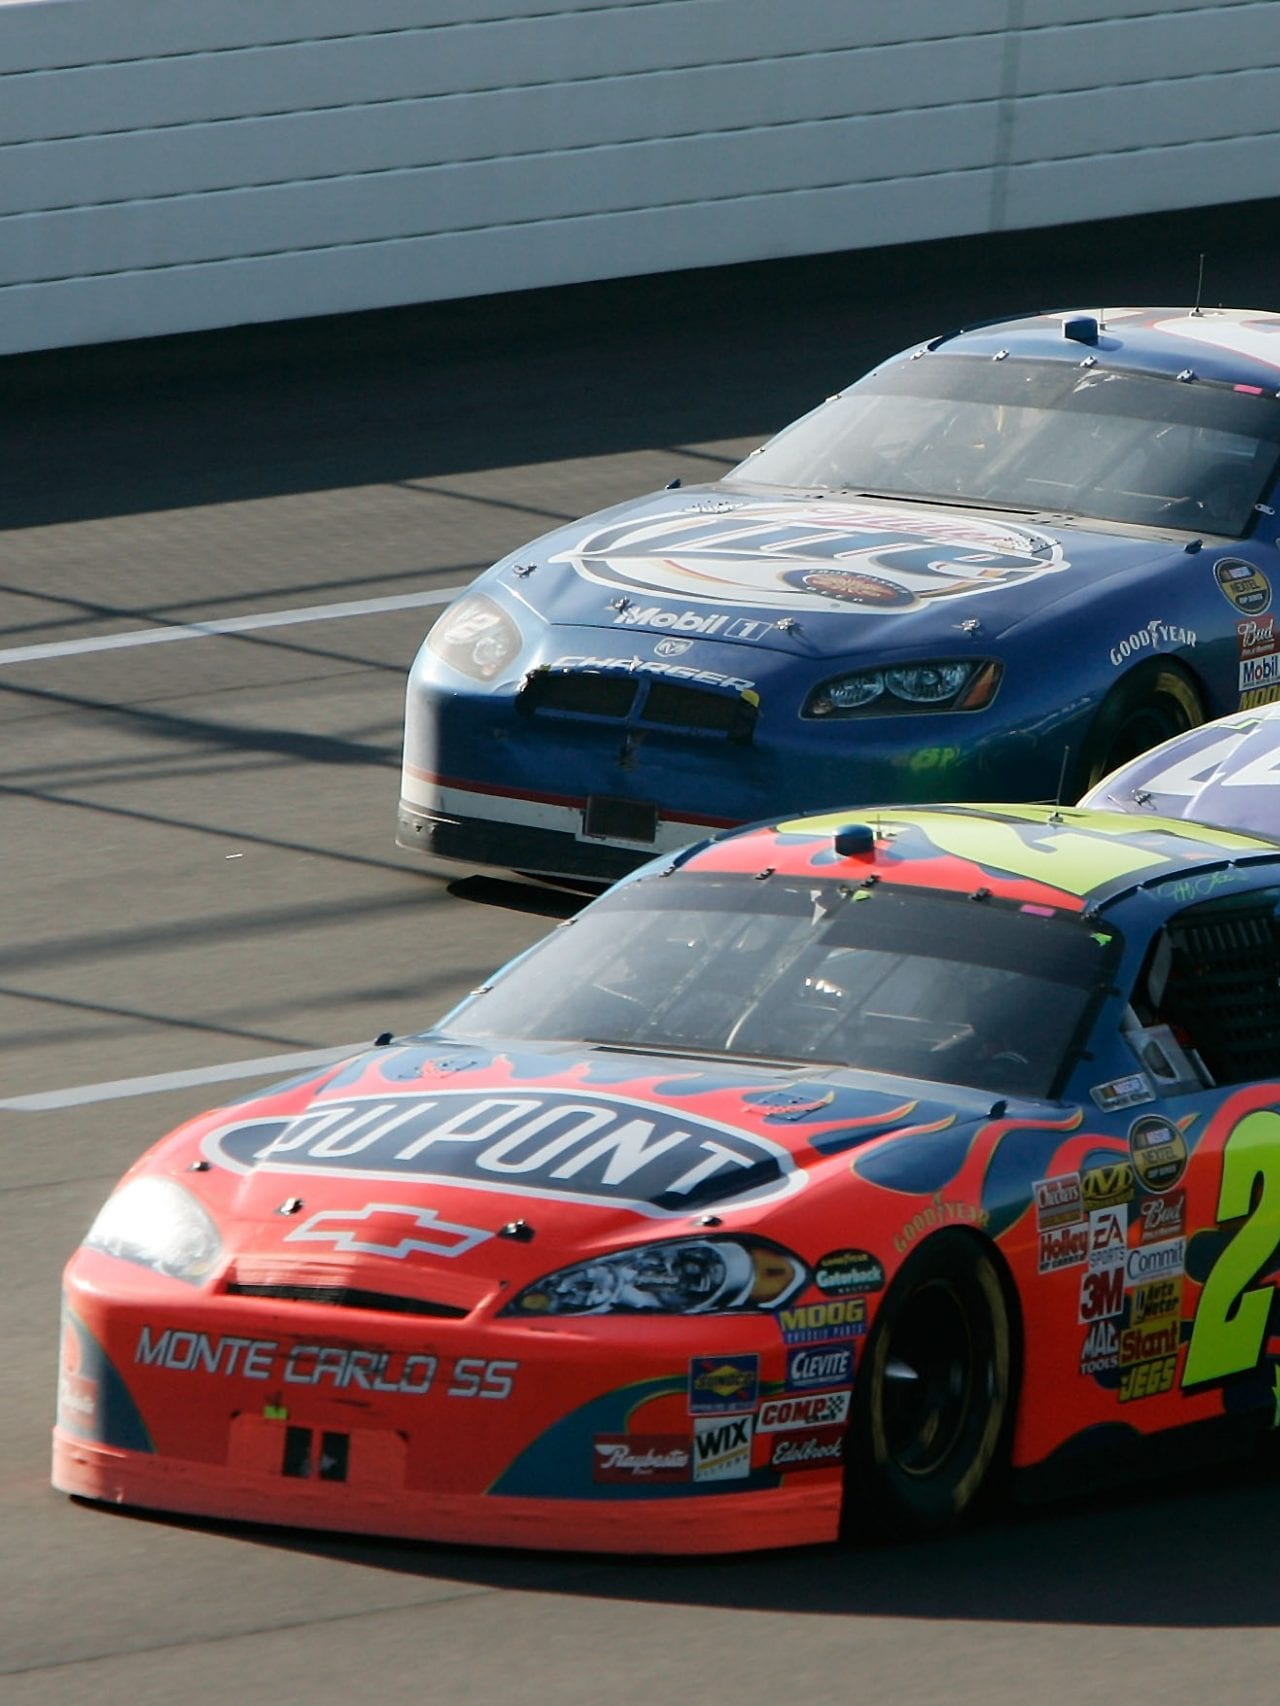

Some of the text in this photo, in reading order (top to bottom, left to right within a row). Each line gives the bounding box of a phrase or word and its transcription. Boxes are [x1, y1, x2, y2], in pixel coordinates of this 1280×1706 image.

[613, 606, 730, 634] Mobil
[1237, 618, 1276, 648] Bud
[1110, 620, 1197, 666] GOODYEAR
[549, 655, 756, 693] CHARGER
[1243, 654, 1279, 684] Mobil
[1141, 1194, 1185, 1230] Bud
[1040, 1229, 1088, 1261] Holley
[1093, 1213, 1124, 1250] EA
[1127, 1241, 1184, 1280] Commit
[1081, 1267, 1125, 1320] 3M
[779, 1299, 865, 1331] MOOG
[1121, 1320, 1178, 1364] Stant
[133, 1325, 516, 1400] MONTE CARLO SS
[790, 1352, 851, 1380] CLEVITE
[1081, 1354, 1118, 1374] TOOLS
[1120, 1357, 1176, 1403] JEGS
[761, 1399, 828, 1427] COMP
[697, 1418, 749, 1460] WIX
[772, 1437, 843, 1465] Edelbrock
